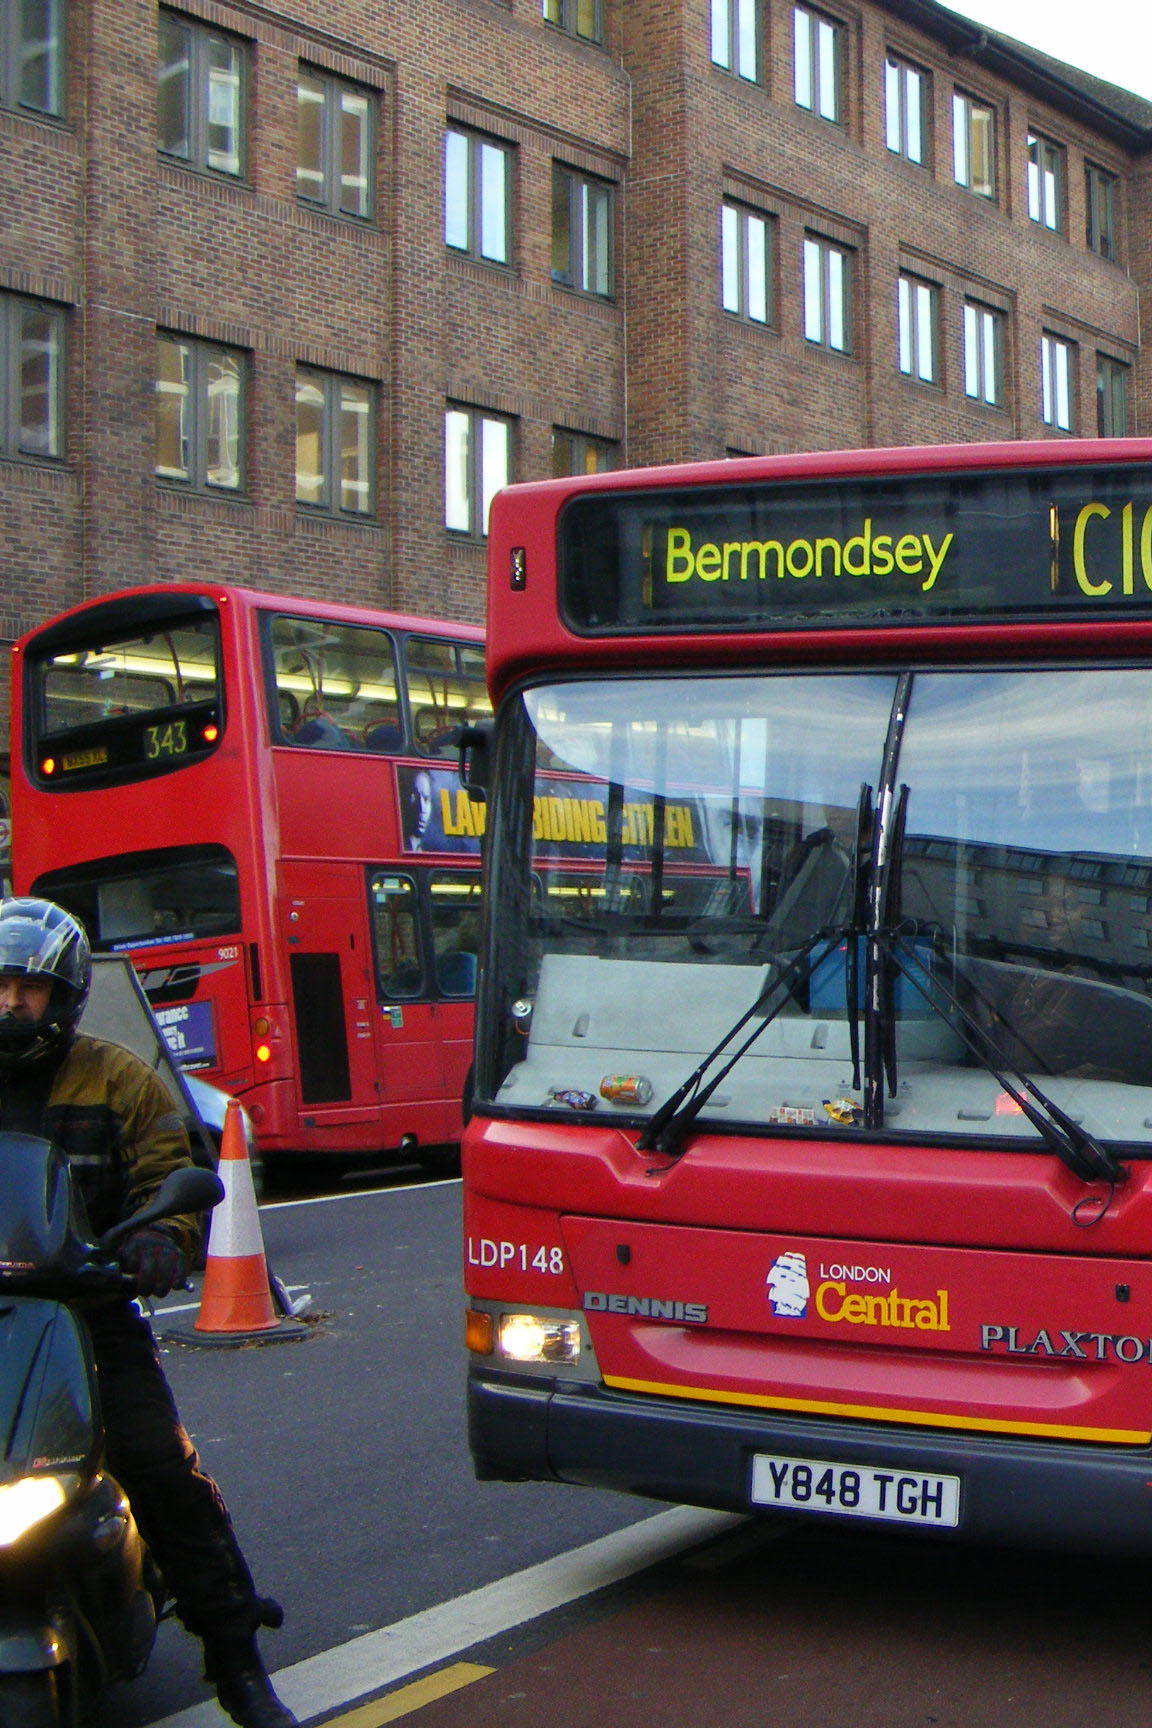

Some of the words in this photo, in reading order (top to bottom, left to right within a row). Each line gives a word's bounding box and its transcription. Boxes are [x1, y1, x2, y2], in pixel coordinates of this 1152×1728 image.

[666, 518, 954, 591] Bermondsey
[148, 721, 188, 758] 343
[532, 795, 606, 843] BIDING
[622, 803, 694, 848] CITIEN
[218, 947, 238, 959] 9021
[467, 1236, 564, 1275] LDP148
[819, 1263, 891, 1284] LONDON
[583, 1291, 708, 1323] DENNIS
[815, 1281, 951, 1331] Central
[769, 1461, 860, 1507] Y848
[873, 1474, 943, 1518] TGH
